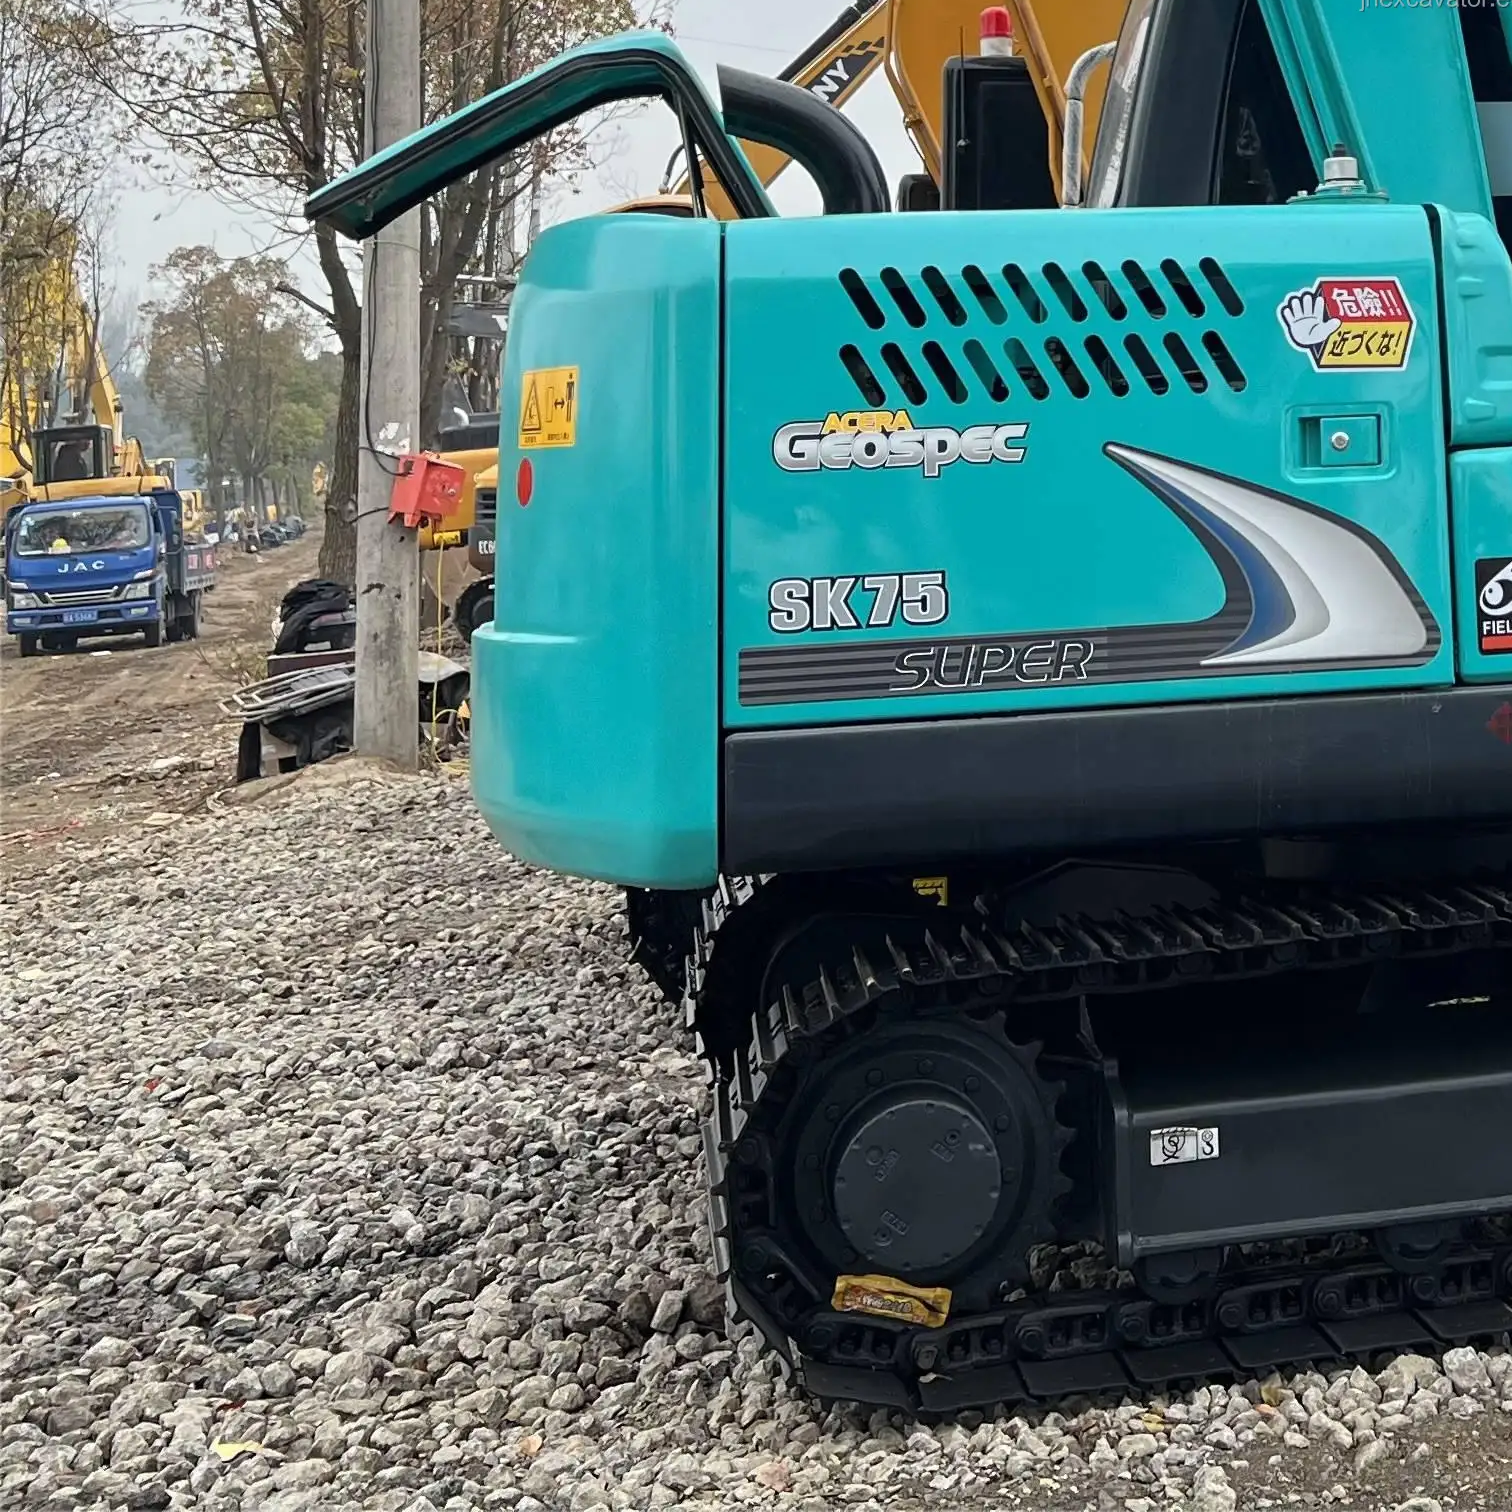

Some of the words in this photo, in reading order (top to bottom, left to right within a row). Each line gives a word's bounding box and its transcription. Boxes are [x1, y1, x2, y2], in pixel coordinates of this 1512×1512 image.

[811, 58, 850, 102] NY
[821, 409, 914, 435] ACERA
[57, 560, 105, 573] JAC
[888, 639, 1096, 692] SUPER
